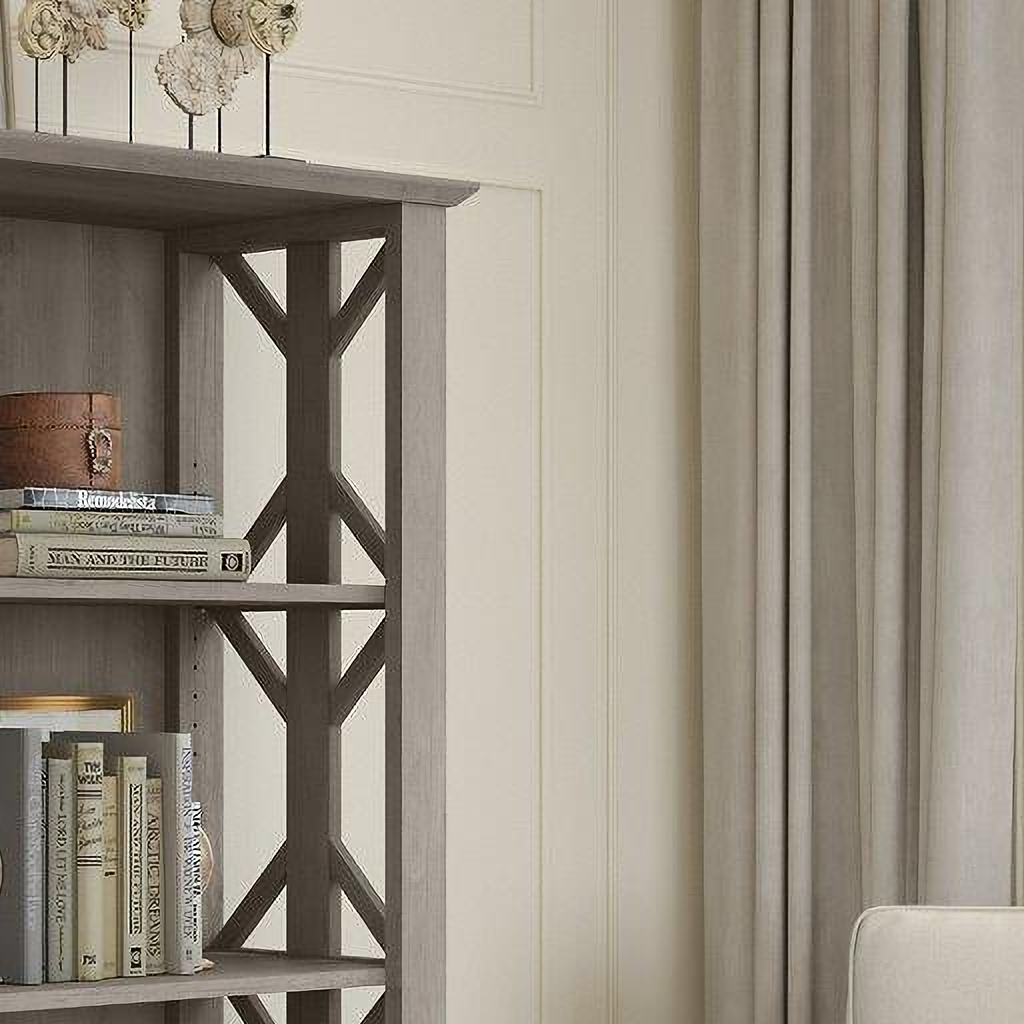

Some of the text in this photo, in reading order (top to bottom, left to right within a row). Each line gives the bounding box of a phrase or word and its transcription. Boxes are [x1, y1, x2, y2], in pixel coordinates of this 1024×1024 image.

[48, 550, 81, 566] MAN
[85, 551, 116, 567] AND
[119, 552, 150, 567] THE
[154, 554, 209, 569] FUTURE
[147, 813, 161, 879] ARCTIC
[146, 885, 161, 958] DREAMS
